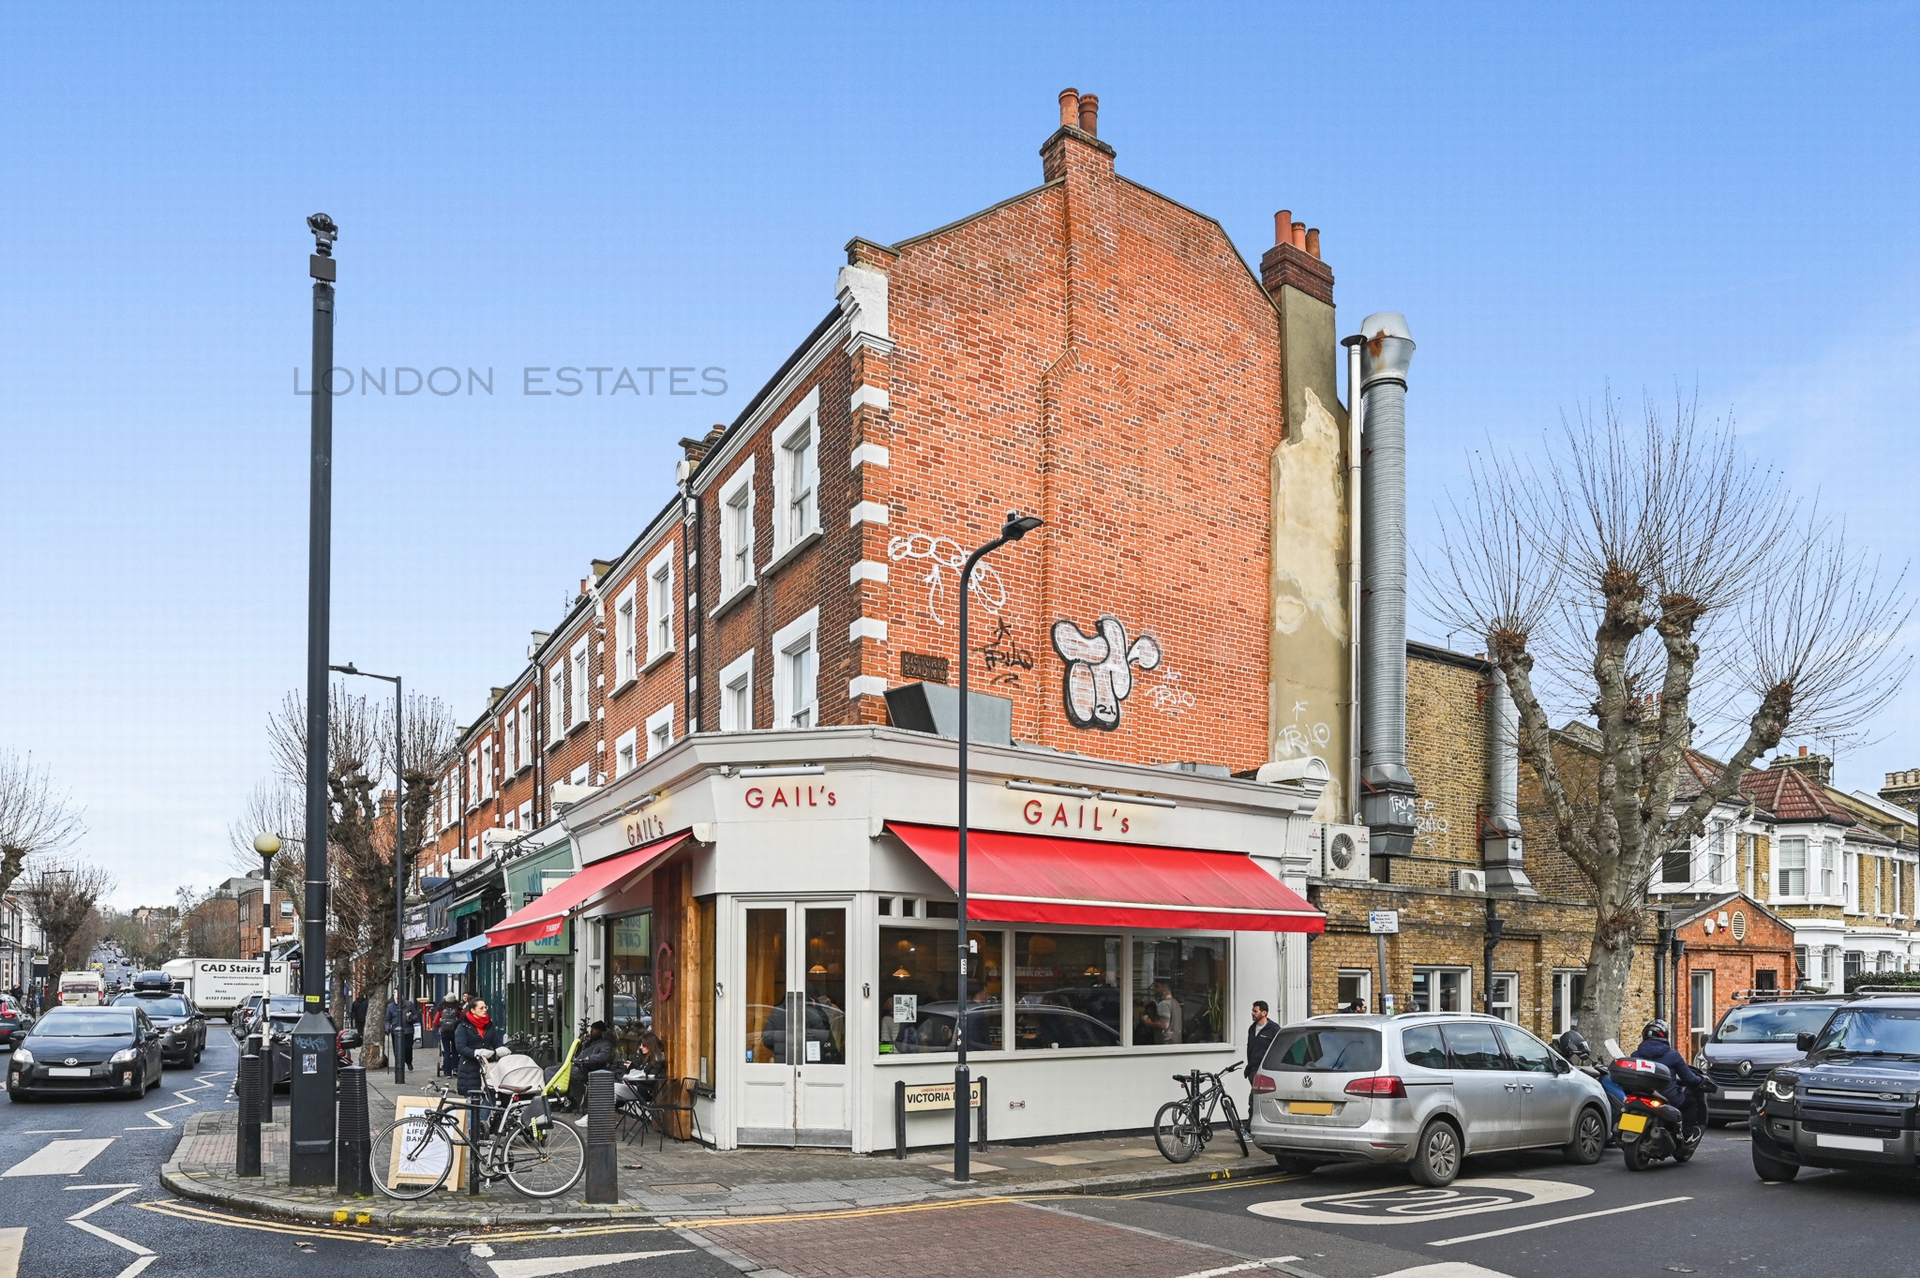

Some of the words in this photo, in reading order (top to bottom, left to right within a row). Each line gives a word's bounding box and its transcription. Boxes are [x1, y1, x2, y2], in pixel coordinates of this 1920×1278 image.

[904, 654, 947, 669] VICTORIA
[904, 664, 928, 677] ROAD
[745, 786, 837, 809] GAIL's
[1023, 799, 1130, 833] GAIL's
[626, 814, 665, 846] GAIL's
[201, 964, 227, 972] CAD
[229, 964, 261, 973] Stairs
[262, 965, 282, 973] td
[656, 942, 673, 1001] G
[1809, 1077, 1902, 1086] DEFENDER
[907, 1092, 950, 1103] VICTORIA
[1323, 1189, 1513, 1215] 20
